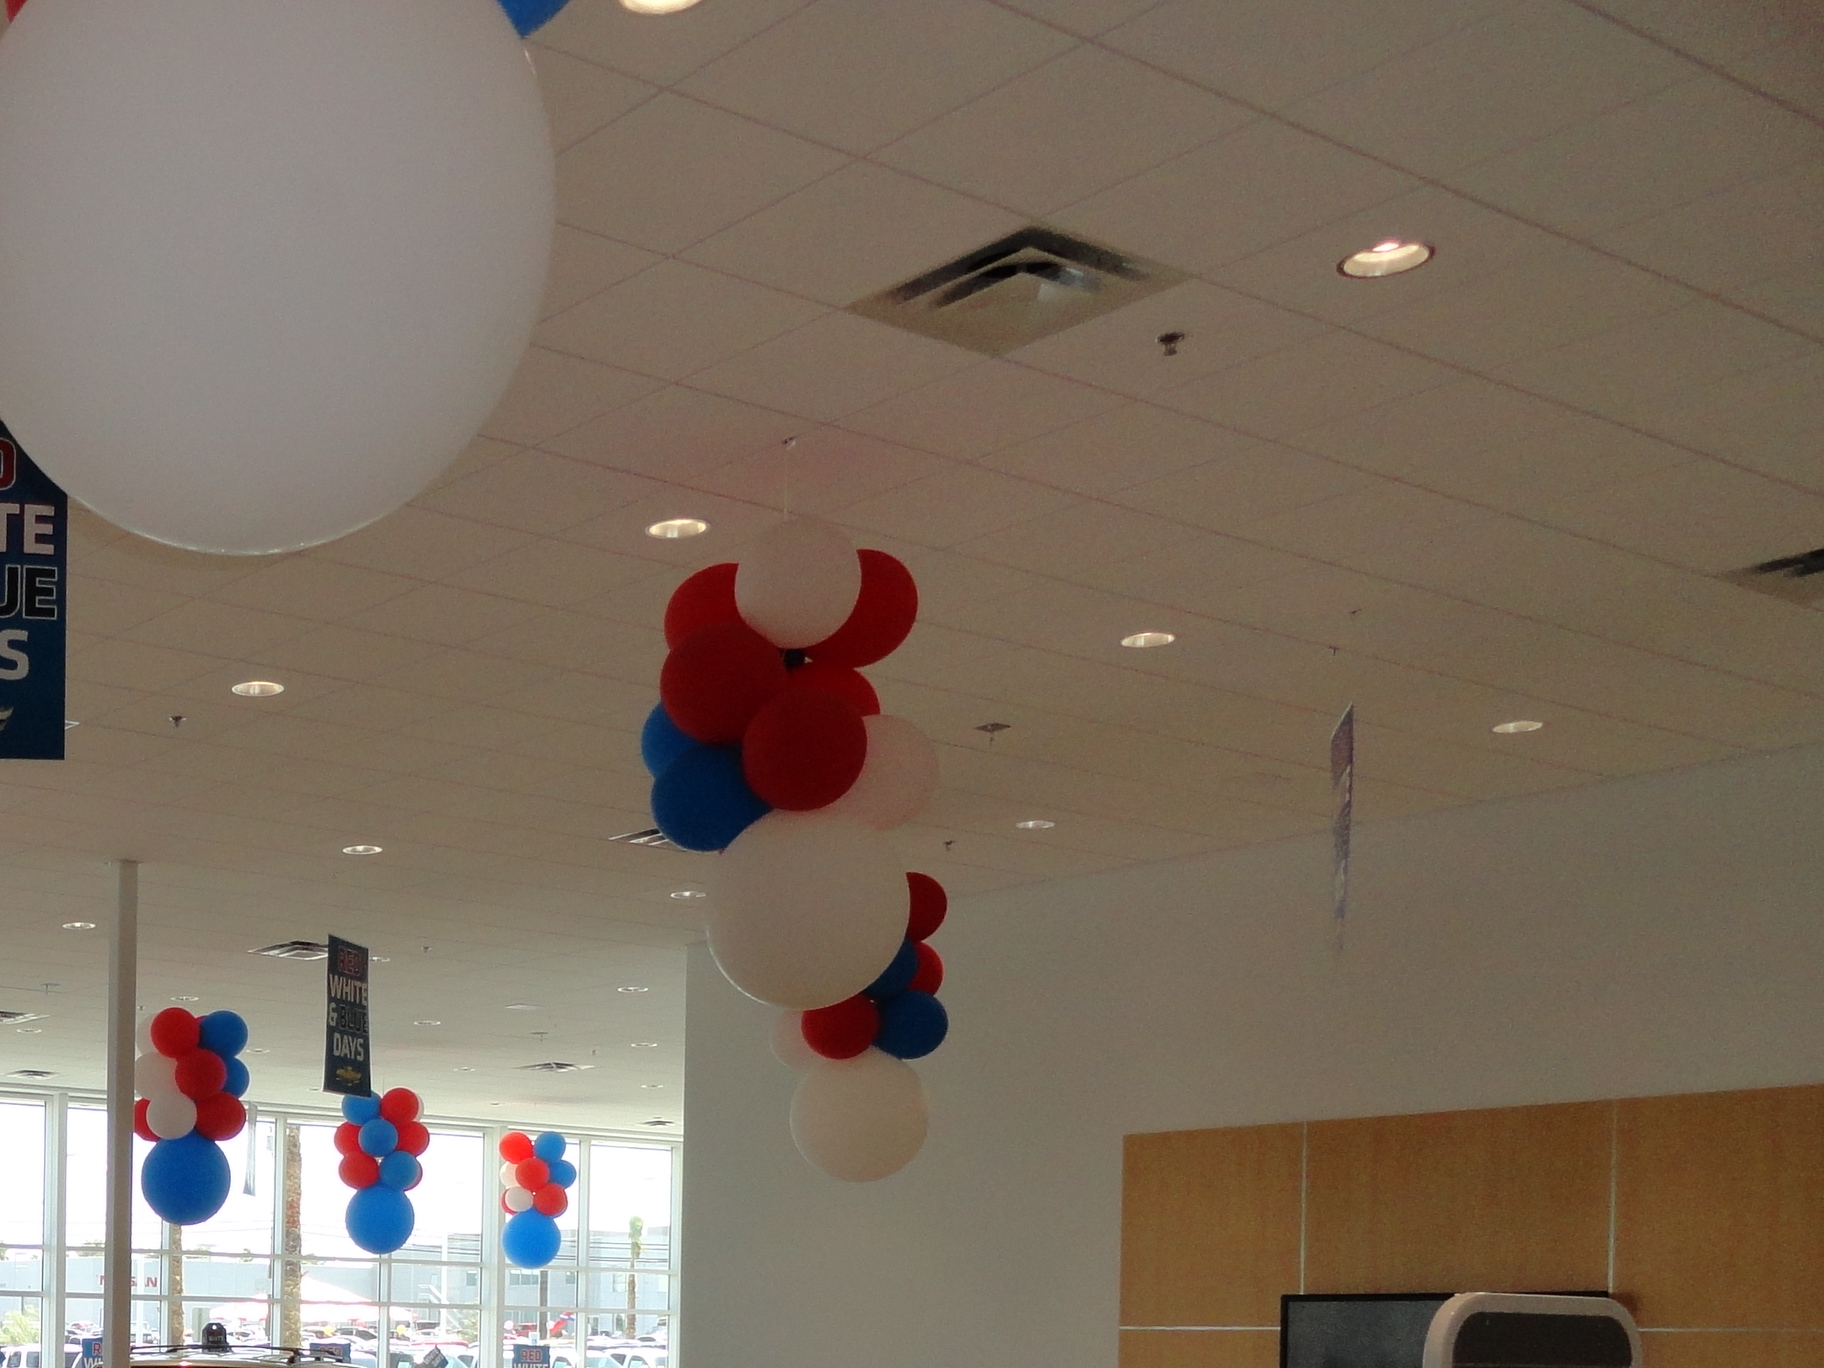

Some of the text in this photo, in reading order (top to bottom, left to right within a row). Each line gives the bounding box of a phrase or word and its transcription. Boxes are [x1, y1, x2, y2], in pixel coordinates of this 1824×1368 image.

[329, 974, 368, 1005] WHITE
[329, 1003, 368, 1035] & BLUE
[333, 1033, 364, 1061] DAYS
[521, 1349, 542, 1362] RED
